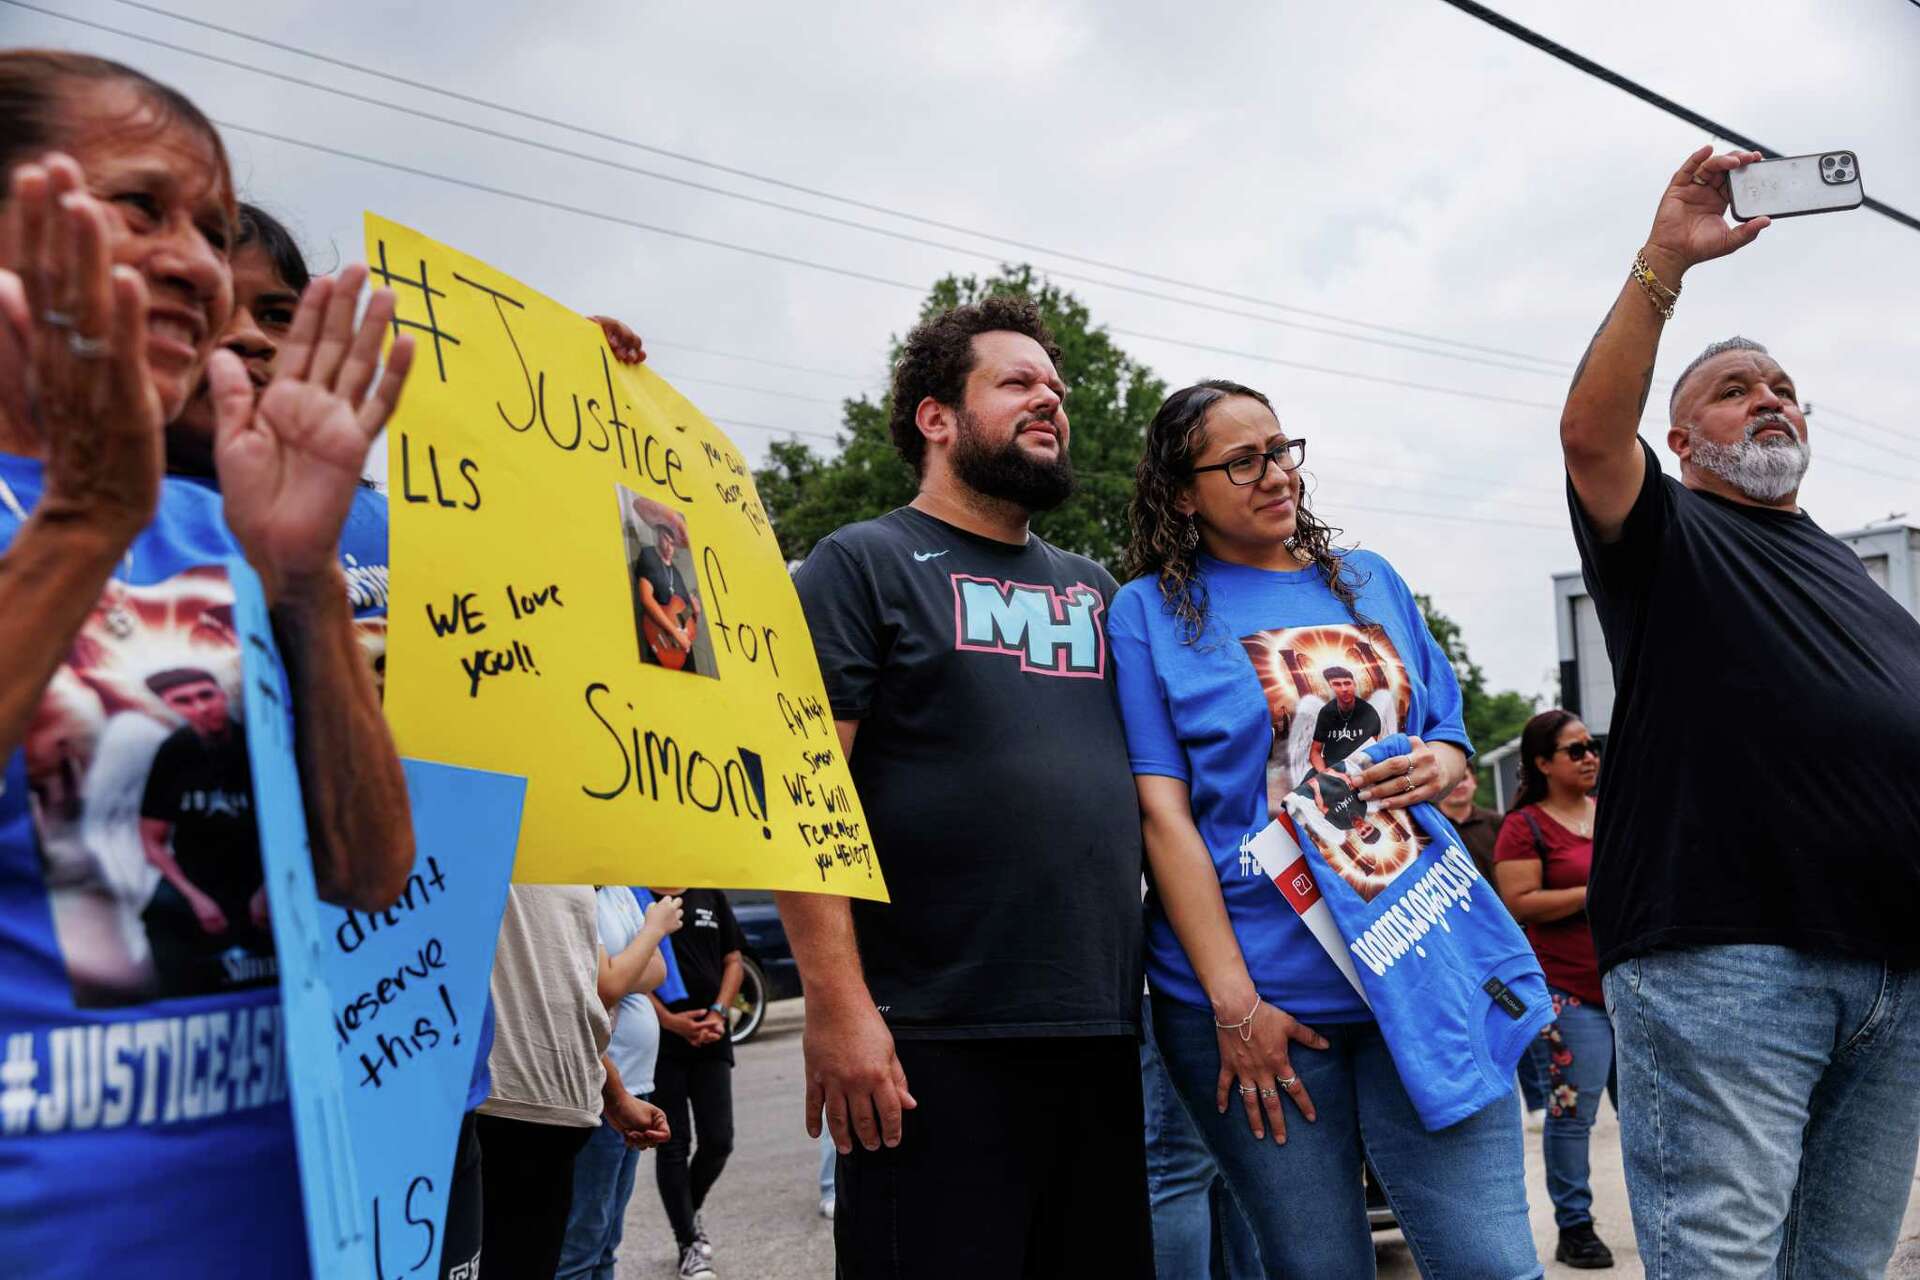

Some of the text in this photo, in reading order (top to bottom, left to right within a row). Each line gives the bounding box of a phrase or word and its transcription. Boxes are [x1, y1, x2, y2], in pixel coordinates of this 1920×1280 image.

[401, 432, 482, 512] LLS
[506, 585, 564, 620] love
[703, 546, 780, 677] for
[952, 575, 1103, 677] MH
[582, 683, 773, 840] Simon!
[360, 984, 461, 1088] this!
